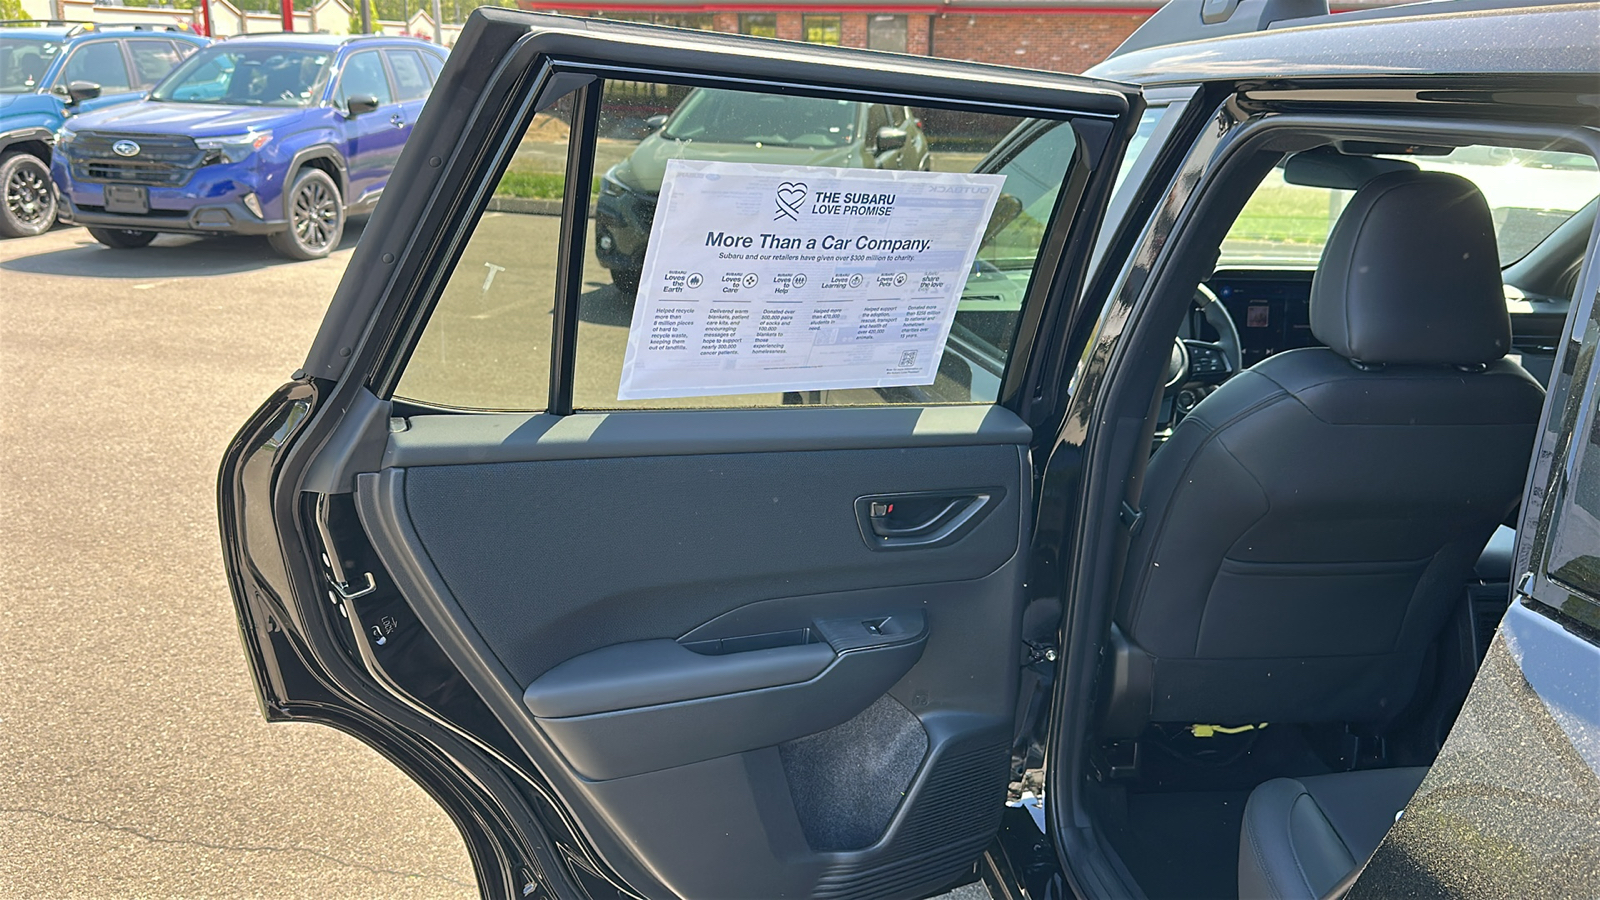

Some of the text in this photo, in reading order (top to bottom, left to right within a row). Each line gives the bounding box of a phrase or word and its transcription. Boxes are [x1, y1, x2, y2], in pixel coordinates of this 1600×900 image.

[815, 192, 841, 203] THE
[844, 193, 896, 205] SUBARU
[812, 205, 892, 216] LOVE PROMISE
[706, 232, 930, 253] More Than a Car Company.
[894, 254, 914, 262] charity.
